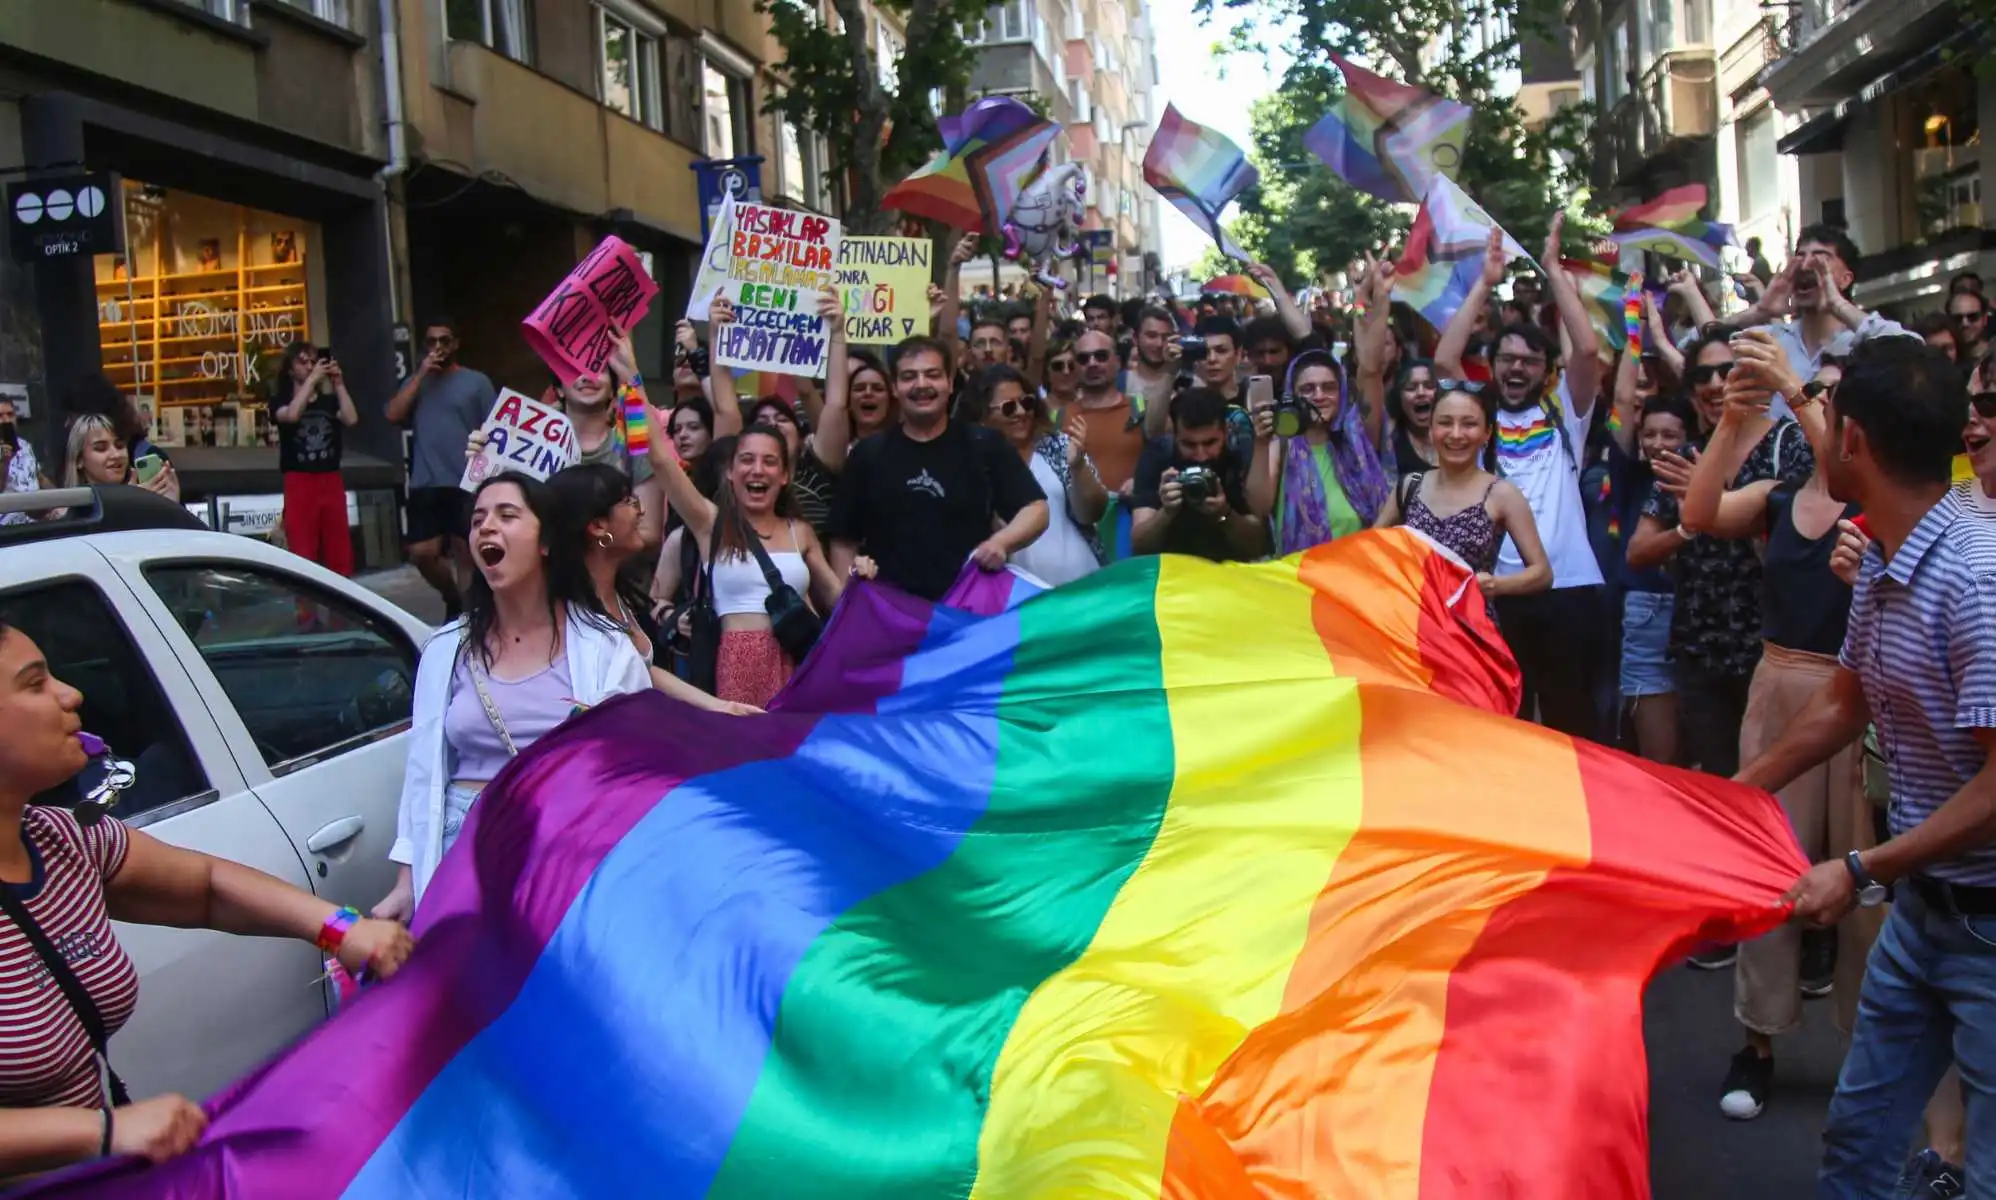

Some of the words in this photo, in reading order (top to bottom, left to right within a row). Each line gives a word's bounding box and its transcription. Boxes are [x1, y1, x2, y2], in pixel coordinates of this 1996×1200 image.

[735, 204, 830, 245] YASAKLAR
[733, 231, 833, 270] BASKILAR
[836, 239, 929, 268] RTINADAN
[834, 270, 871, 285] ONRA
[718, 326, 825, 366] HAYATTAN
